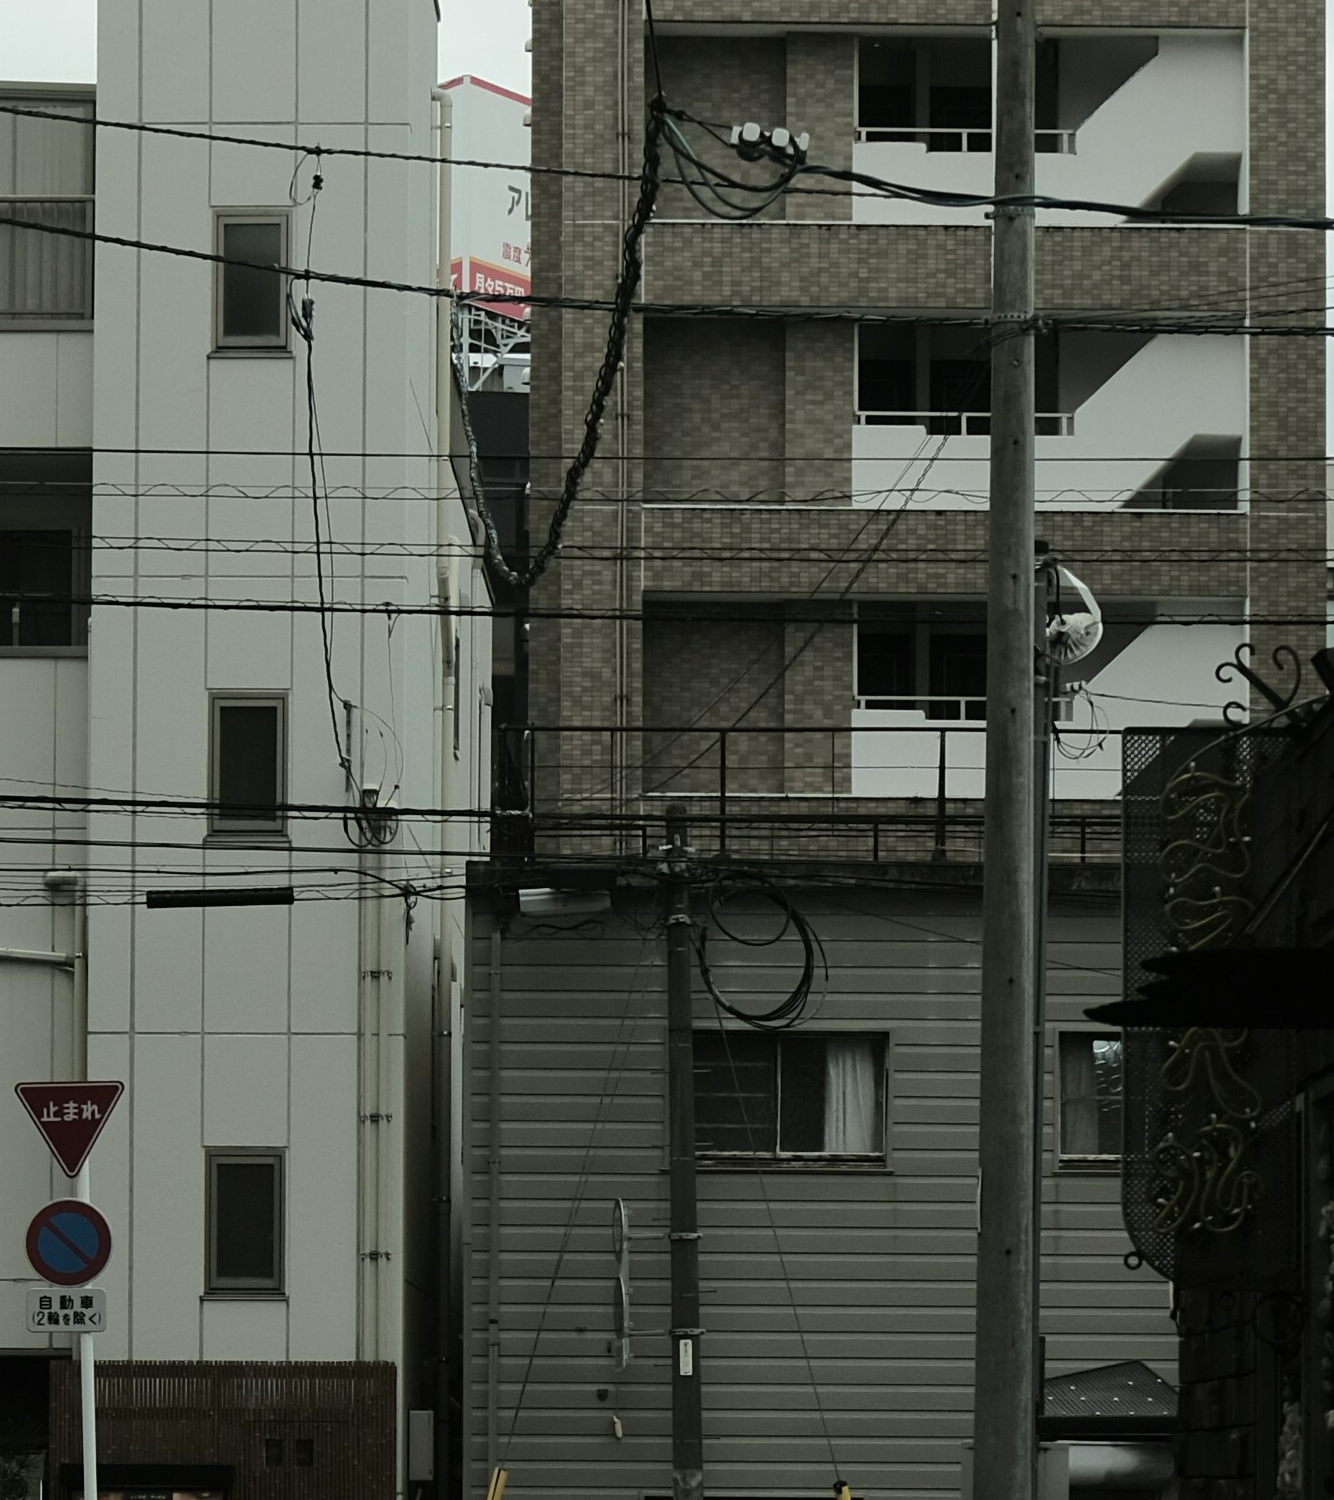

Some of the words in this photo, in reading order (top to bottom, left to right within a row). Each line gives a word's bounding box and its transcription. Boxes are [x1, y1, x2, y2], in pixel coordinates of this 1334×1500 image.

[40, 1100, 102, 1122] 止まれ
[39, 1295, 94, 1310] 自動車
[32, 1310, 102, 1326] (2輪を除く)
